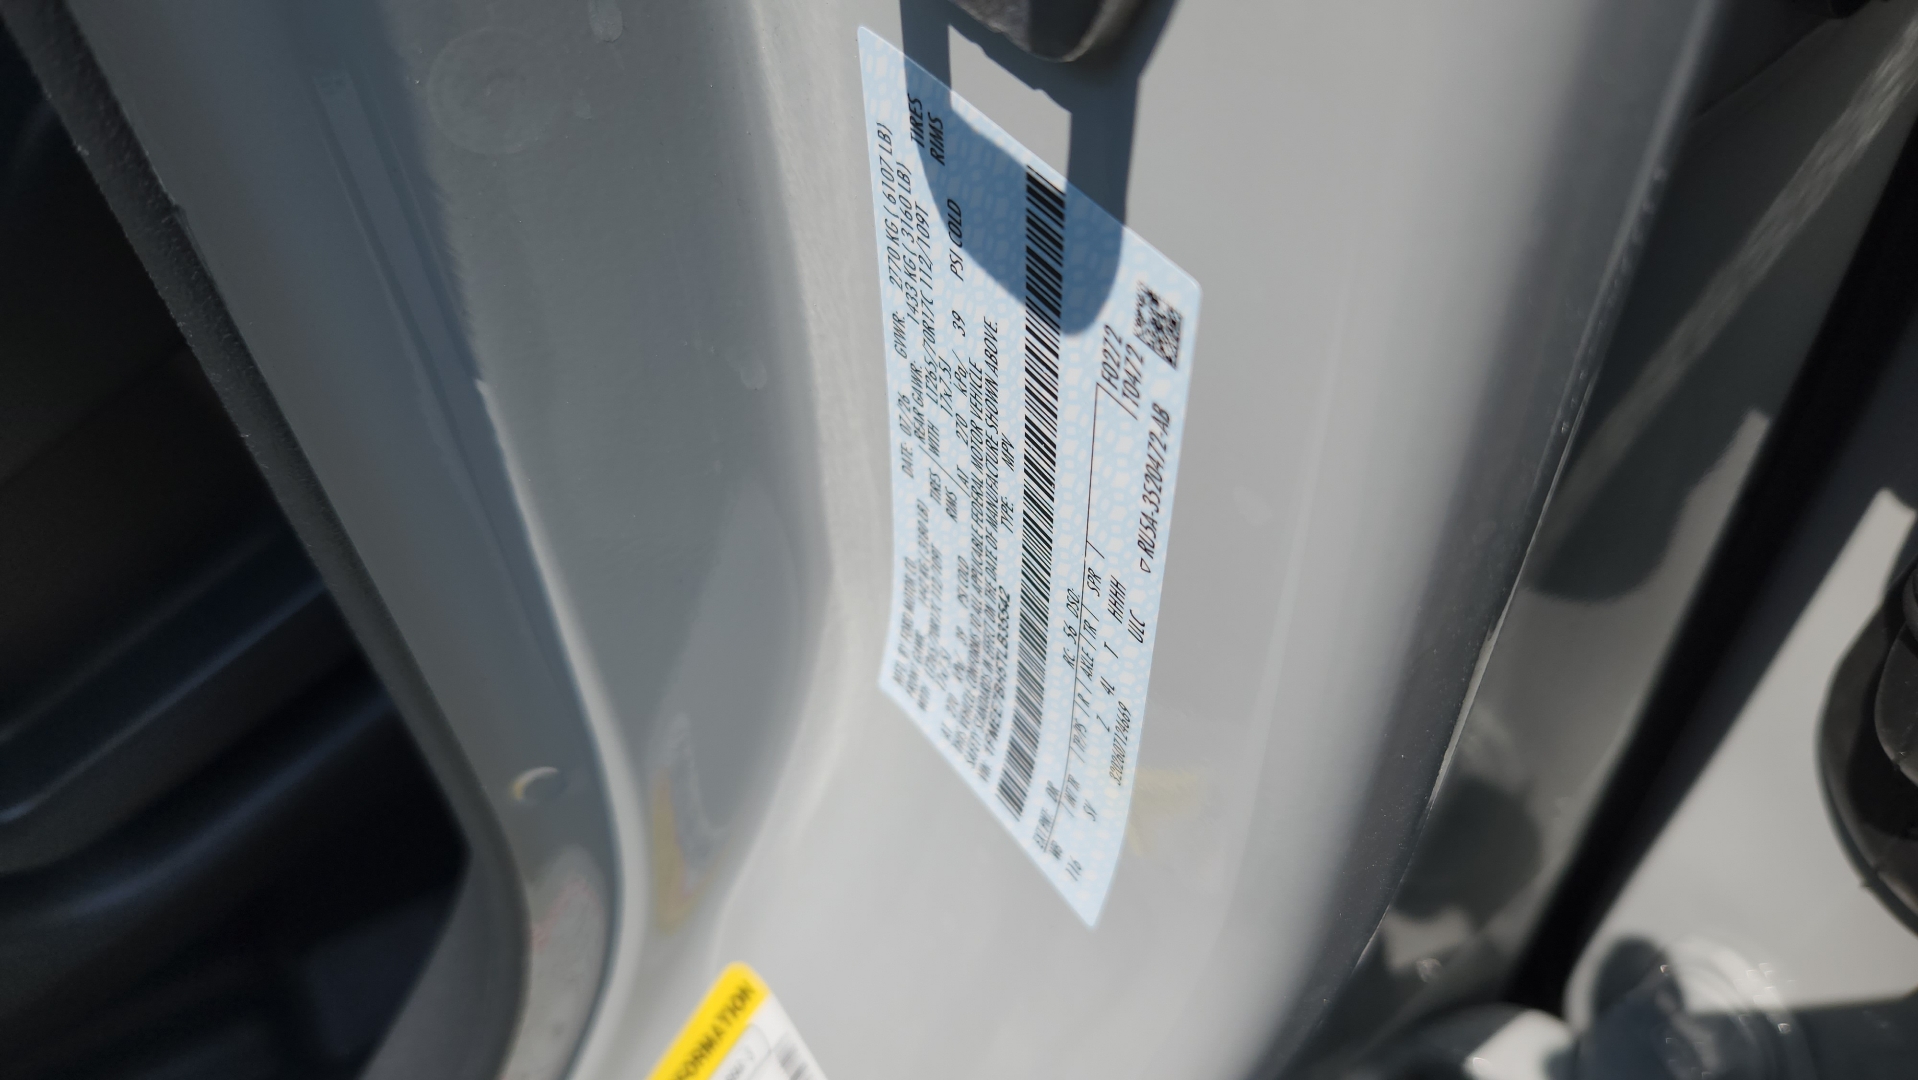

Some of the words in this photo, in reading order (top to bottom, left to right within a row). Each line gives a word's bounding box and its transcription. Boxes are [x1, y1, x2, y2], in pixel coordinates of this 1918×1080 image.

[876, 122, 892, 156] LB)
[907, 93, 925, 148] TIRES
[927, 111, 945, 166] RIMS
[879, 155, 896, 205] 6107
[896, 162, 911, 194] LB)
[884, 218, 900, 246] KG
[898, 194, 914, 244] 3160
[947, 198, 962, 248] COLD
[914, 201, 933, 290] 112/109T
[886, 246, 903, 291] 2770
[902, 254, 917, 283] KG
[949, 248, 964, 282] PSI
[904, 281, 919, 325] 1433
[892, 311, 907, 359] GVWR:
[952, 310, 966, 337] 39
[920, 290, 938, 405] LT265/70R17C
[984, 316, 998, 378] ABOVE.
[1101, 324, 1122, 390] F0272
[910, 362, 924, 408] GAWR:
[938, 356, 952, 417] 17x7.5J
[952, 350, 968, 397] kPa/
[968, 357, 982, 421] VEHICLE
[1122, 343, 1144, 408] T0472
[898, 392, 912, 437] 07/26
[984, 372, 998, 435] SHOWN
[912, 406, 925, 444] REAR
[927, 420, 940, 457] WITH
[955, 412, 969, 446] 270
[900, 442, 914, 479] DATE:
[970, 419, 983, 474] MOTOR
[1001, 432, 1014, 472] MPV
[928, 468, 941, 505] TIRES
[956, 464, 969, 489] AT
[985, 430, 999, 532] MANUFACTURE
[1137, 402, 1170, 560] RU5A-3520472-AB
[944, 486, 958, 523] RIMS
[971, 472, 984, 529] FEDERAL
[1000, 496, 1014, 534] TYPE:
[985, 527, 998, 550] OF
[957, 555, 969, 589] COLD
[971, 524, 983, 595] APPLICABLE
[985, 546, 998, 582] DATE
[957, 586, 968, 608] PSI
[984, 577, 996, 605] THE
[1086, 567, 1102, 597] SPR
[1107, 575, 1126, 624] HHHH
[971, 594, 982, 616] ALL
[984, 604, 996, 624] ON
[1066, 588, 1080, 619] DSO:
[970, 613, 981, 633] TO
[983, 618, 995, 660] EFFECT
[1063, 621, 1077, 645] 56
[1083, 619, 1097, 640] TR
[1128, 609, 1146, 644] ULC
[1062, 647, 1075, 670] RC:
[1080, 646, 1094, 681] AXLE
[1104, 641, 1118, 659] T
[1077, 692, 1090, 708] R
[1100, 676, 1115, 695] 4L
[1072, 718, 1087, 752] TP/PS
[1096, 714, 1110, 733] Z
[1109, 700, 1131, 786] 3202607124669
[1067, 774, 1080, 791] TR
[1083, 799, 1097, 822] SV
